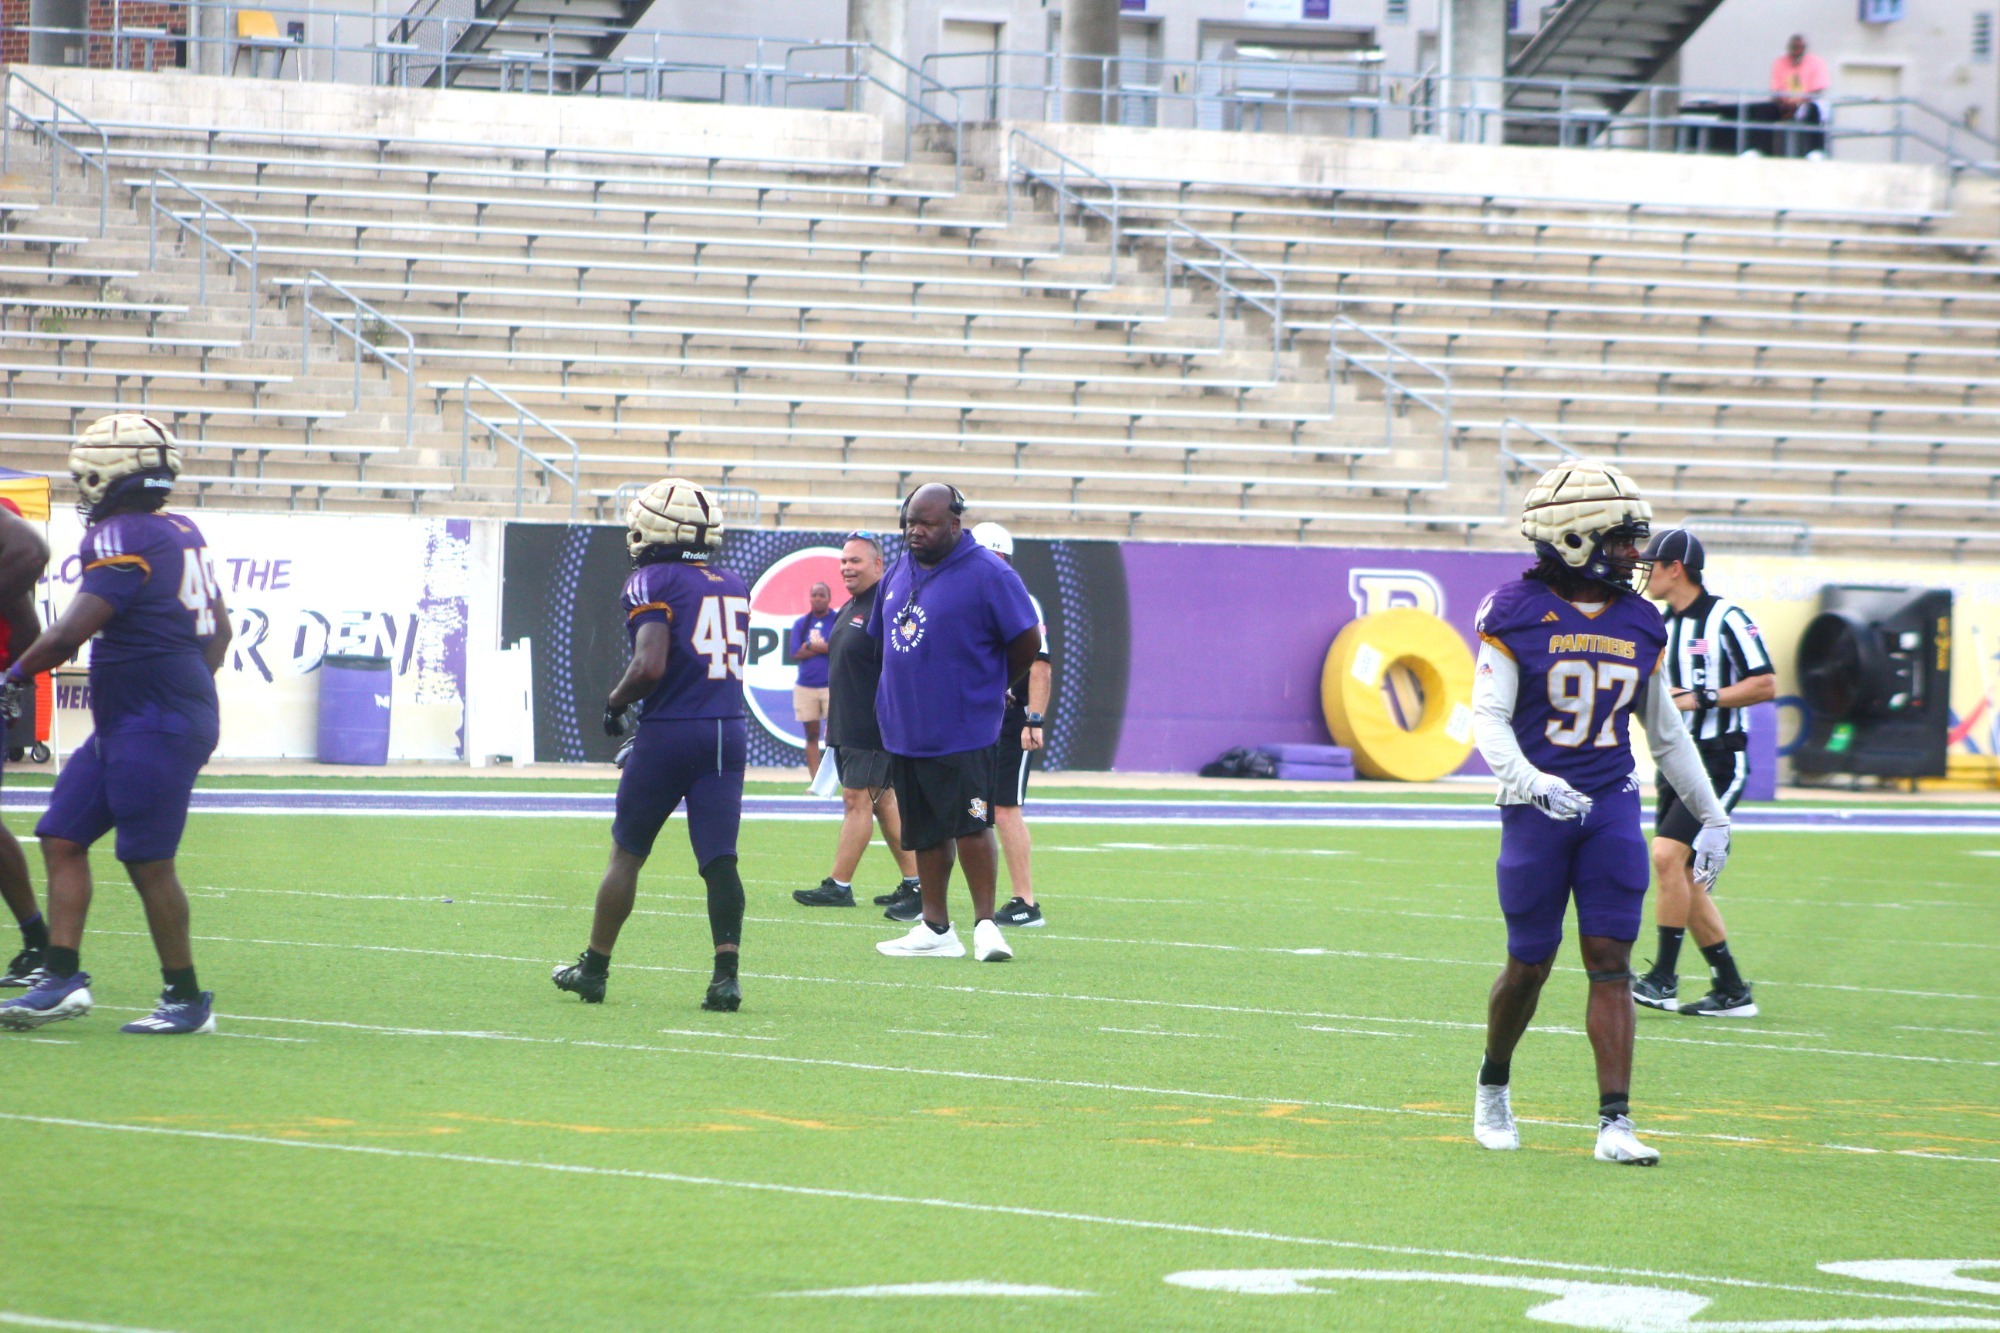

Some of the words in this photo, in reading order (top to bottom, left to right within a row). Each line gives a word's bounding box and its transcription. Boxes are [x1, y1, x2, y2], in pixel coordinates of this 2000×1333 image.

[226, 558, 292, 593] THE
[691, 594, 749, 681] 45
[892, 604, 927, 625] PATHERS
[292, 608, 420, 677] DEN
[1548, 633, 1636, 660] PANTHERS
[1544, 659, 1639, 748] 97
